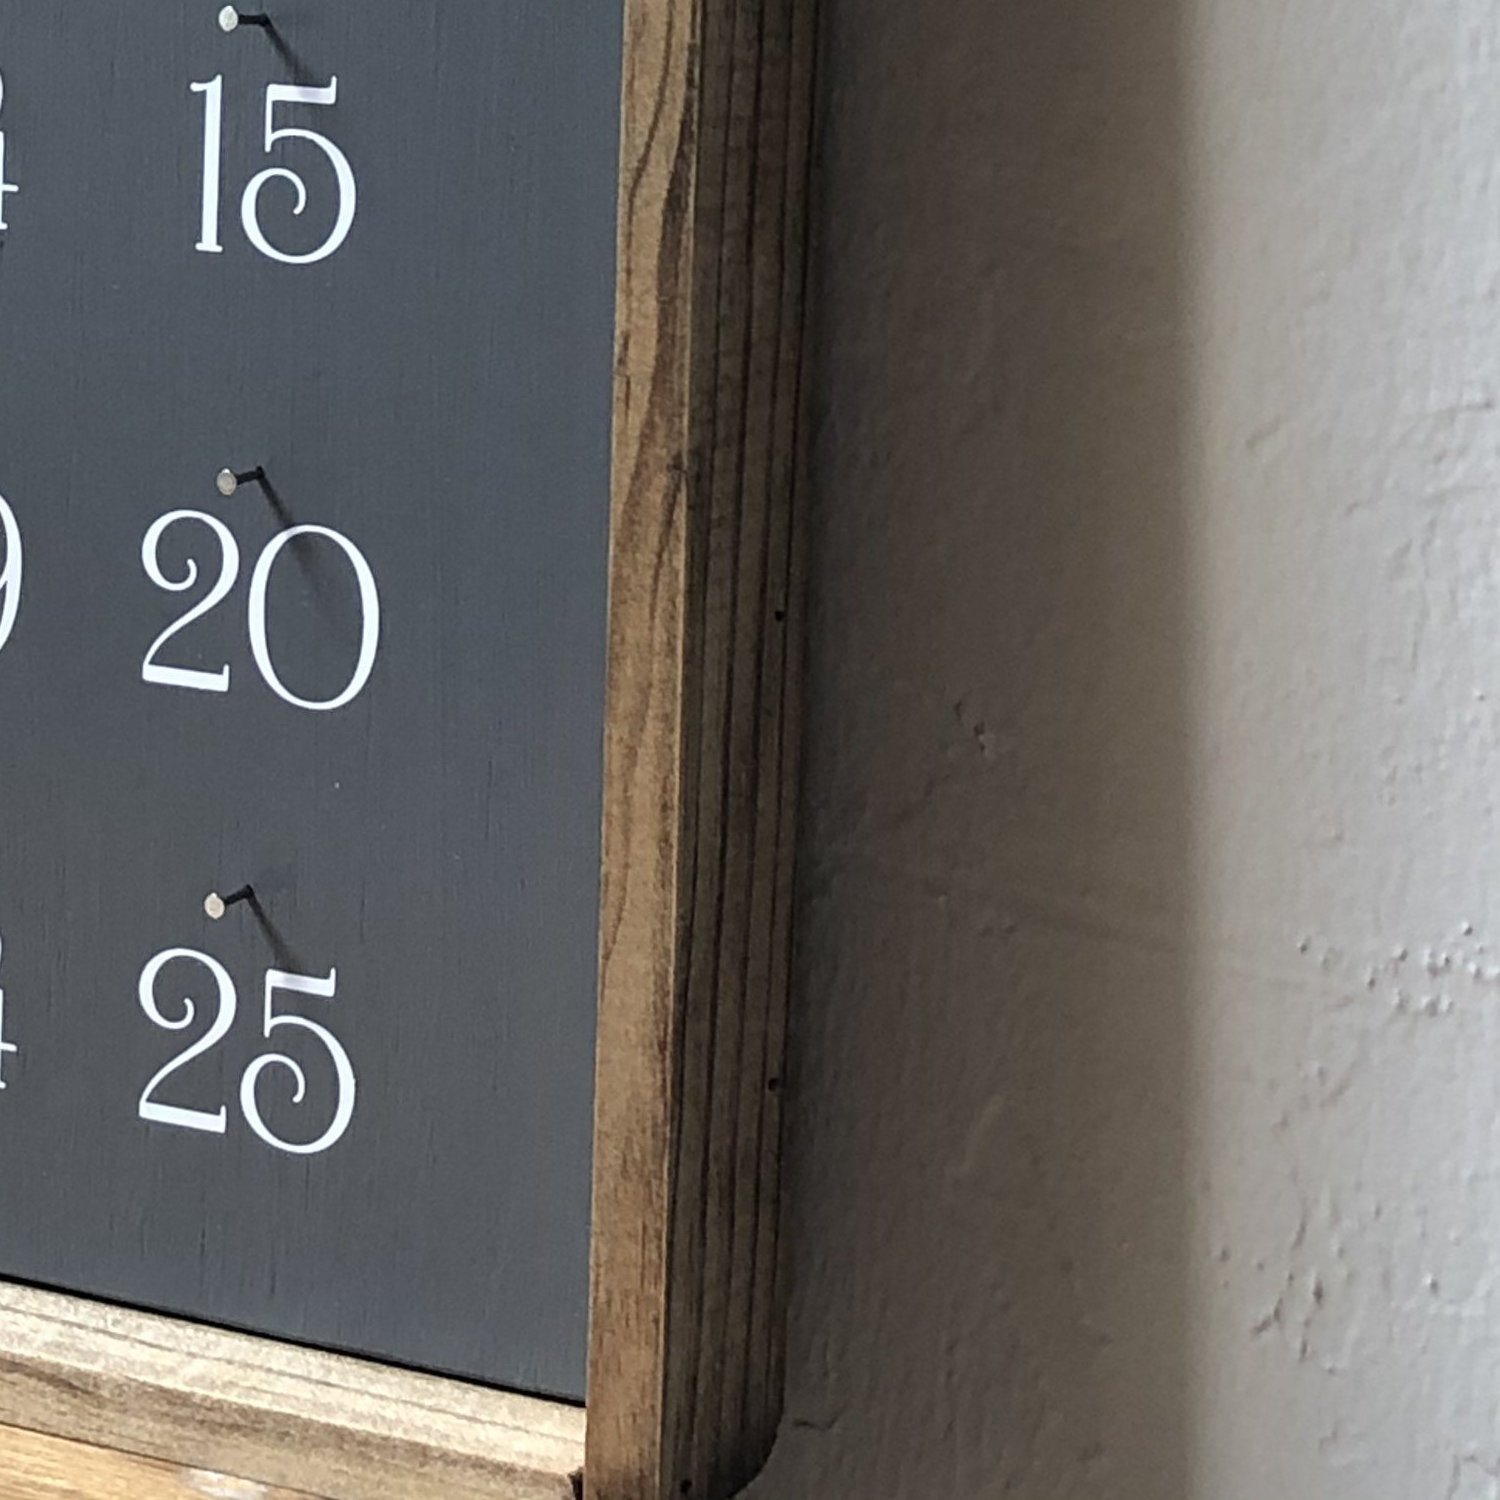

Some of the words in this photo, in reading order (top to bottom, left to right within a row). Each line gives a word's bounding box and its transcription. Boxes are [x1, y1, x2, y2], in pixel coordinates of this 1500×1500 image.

[189, 74, 357, 264] 15
[141, 509, 380, 711] 20
[138, 947, 356, 1155] 25
